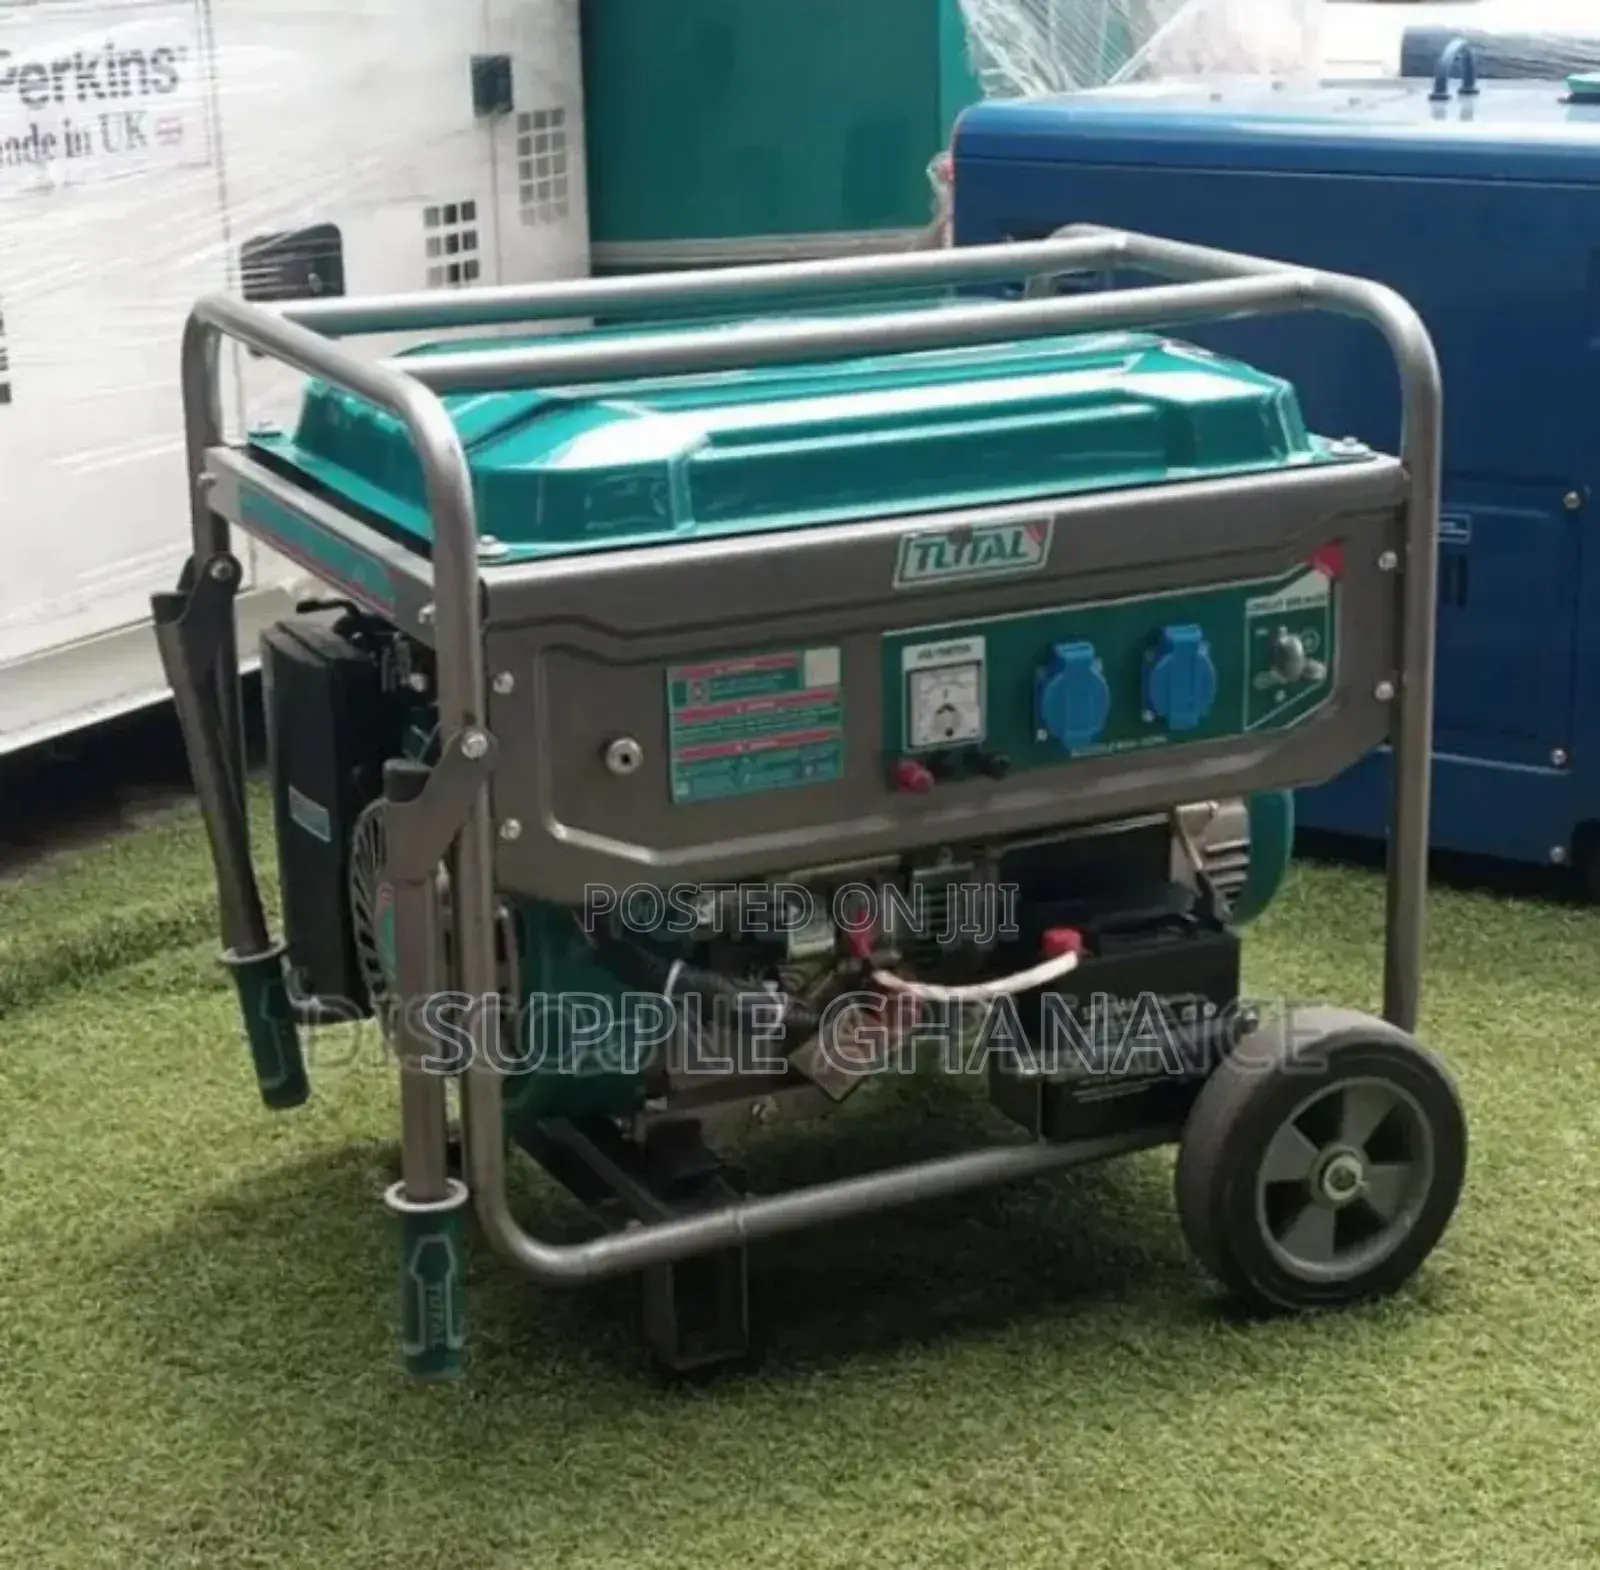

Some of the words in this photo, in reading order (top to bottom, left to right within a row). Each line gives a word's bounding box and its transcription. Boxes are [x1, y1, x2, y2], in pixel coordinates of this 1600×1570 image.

[0, 122, 56, 166] ade
[63, 118, 93, 158] in
[98, 110, 148, 153] UK
